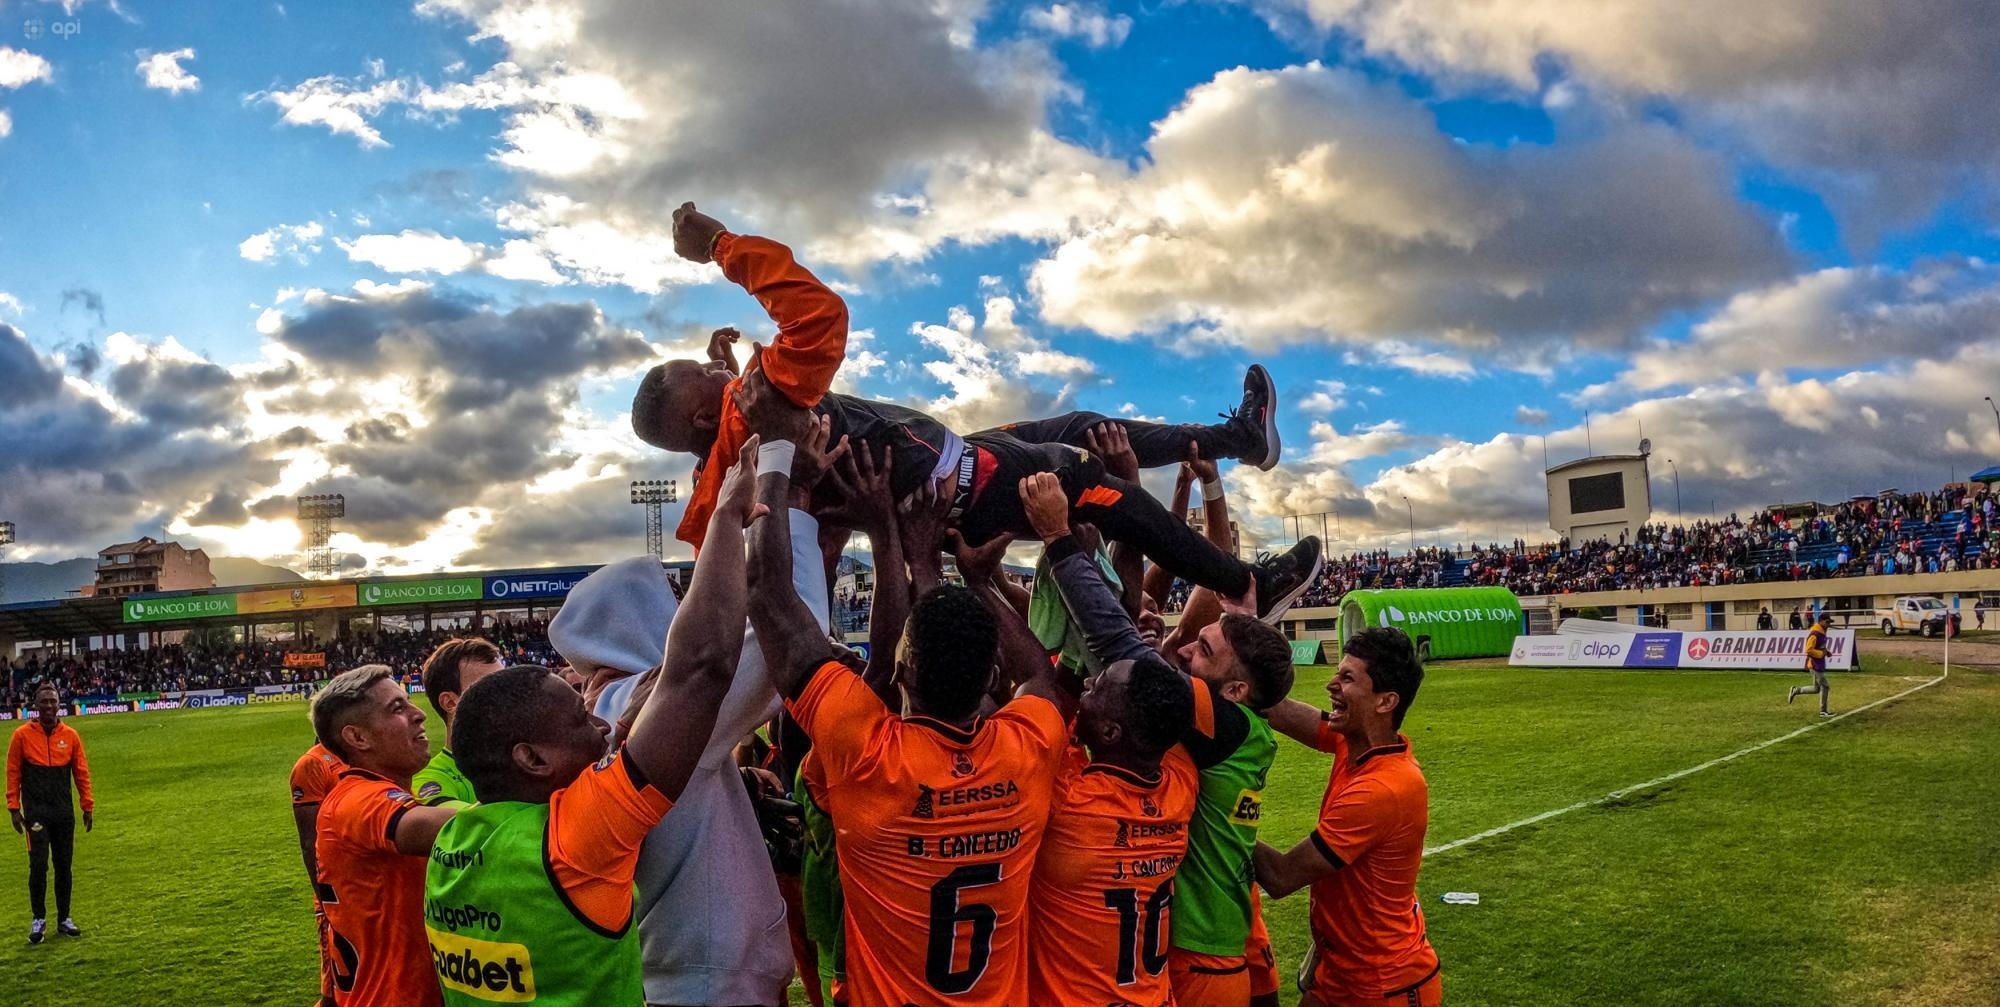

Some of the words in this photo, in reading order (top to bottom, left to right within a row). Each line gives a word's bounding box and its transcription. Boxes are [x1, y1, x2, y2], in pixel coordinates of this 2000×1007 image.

[958, 456, 974, 487] PUMA
[384, 587, 425, 599] BANCO
[429, 586, 443, 596] DE
[447, 584, 473, 595] LOJA
[146, 603, 185, 615] BANCO
[188, 602, 202, 612] DE
[204, 600, 230, 611] LOJA
[1407, 608, 1461, 625] BANCO
[1463, 607, 1484, 622] DE
[1487, 607, 1517, 624] LOJA
[1583, 640, 1621, 659] clipp
[1711, 637, 1846, 654] GRANDAVIAON
[86, 703, 129, 715] multicines
[144, 700, 180, 710] multicin
[938, 780, 1019, 806] EERSSA
[908, 836, 932, 857] B.
[940, 827, 1023, 858] CAICEDO
[1112, 861, 1128, 880] J.
[429, 898, 502, 933] LigaPro
[925, 863, 1003, 995] 6
[1103, 876, 1176, 986] 10
[430, 943, 526, 993] cuabet
